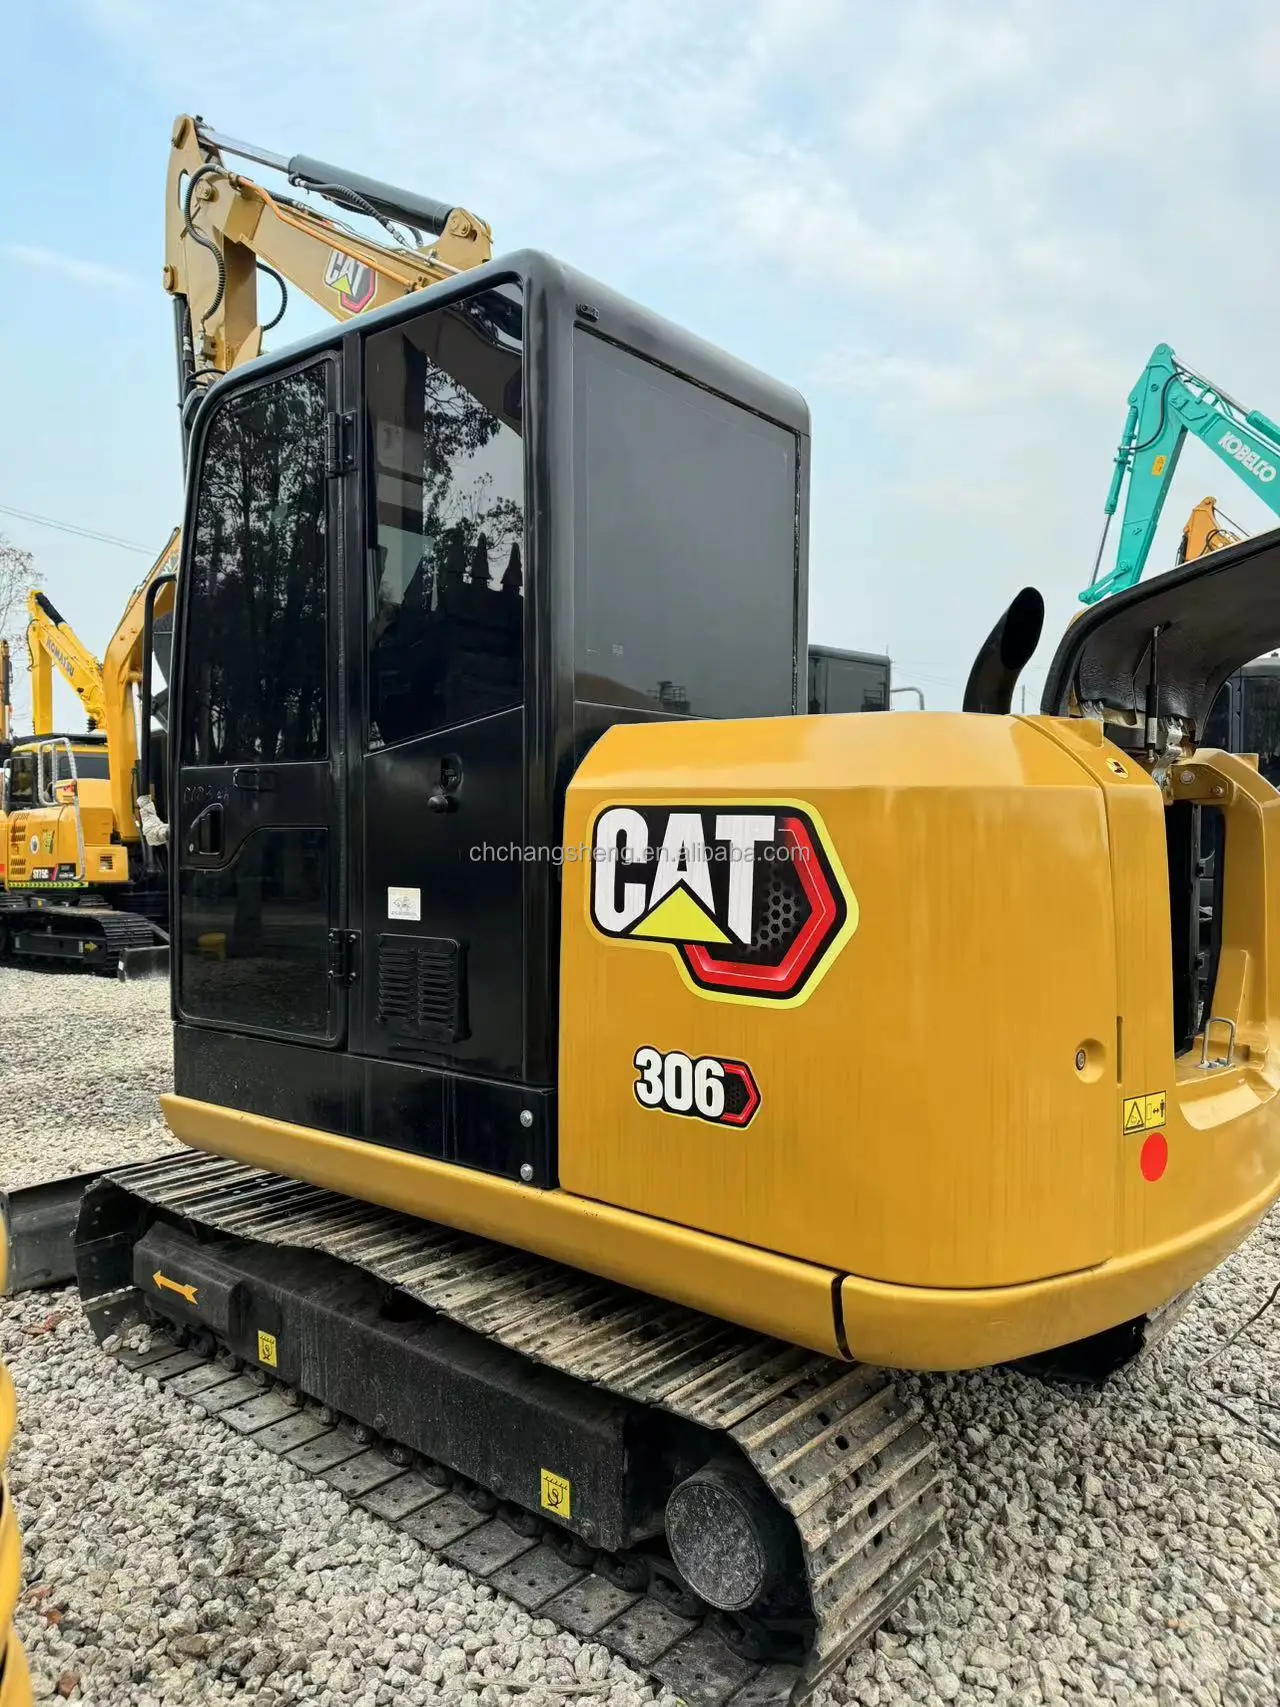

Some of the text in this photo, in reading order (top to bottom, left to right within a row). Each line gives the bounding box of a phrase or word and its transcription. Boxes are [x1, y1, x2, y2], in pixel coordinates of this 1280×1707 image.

[325, 251, 366, 297] CAT
[1218, 431, 1277, 482] KOBELCO
[594, 807, 776, 945] CAT
[635, 1047, 725, 1118] 306
